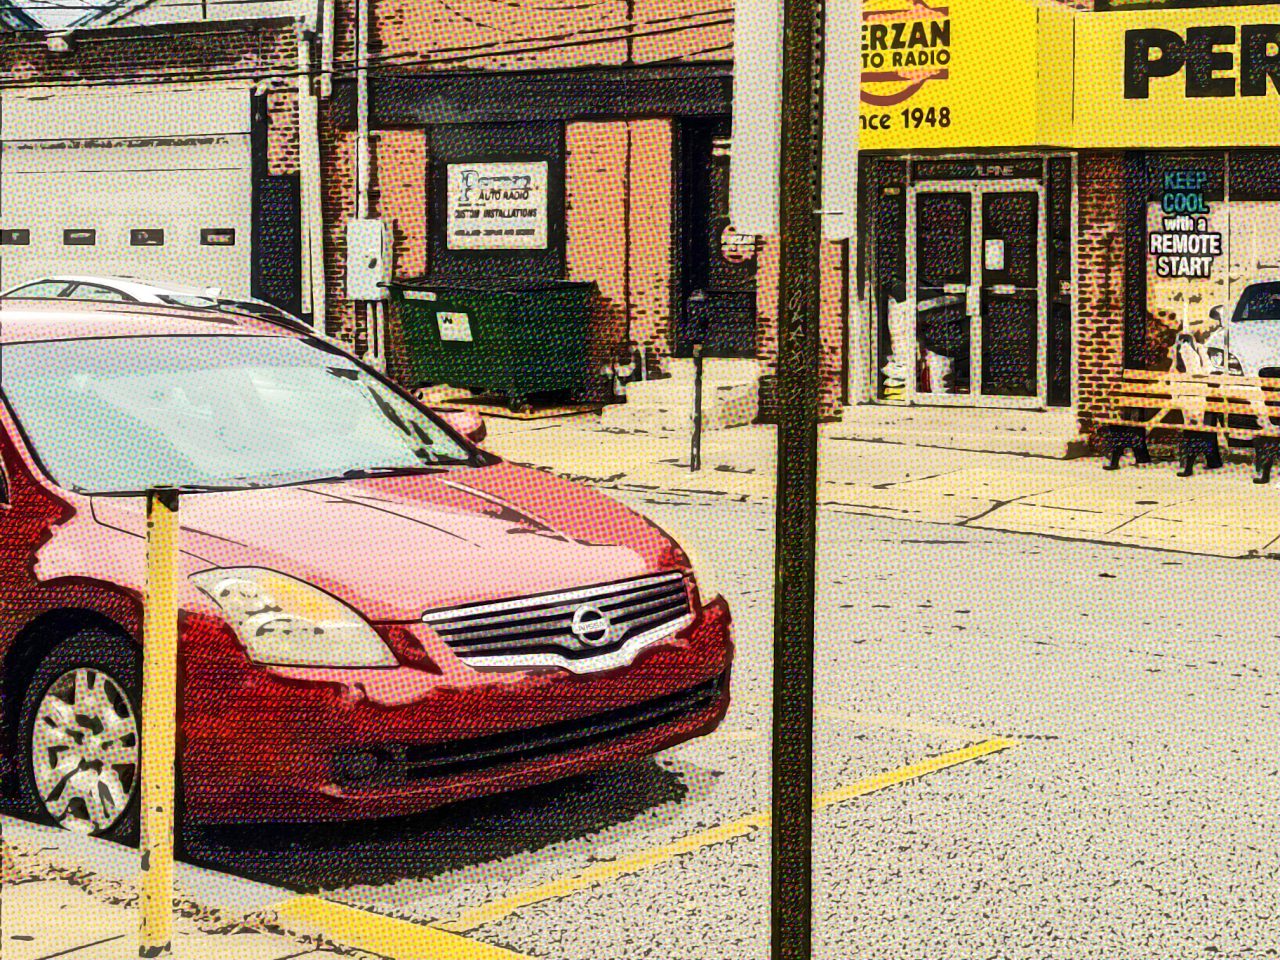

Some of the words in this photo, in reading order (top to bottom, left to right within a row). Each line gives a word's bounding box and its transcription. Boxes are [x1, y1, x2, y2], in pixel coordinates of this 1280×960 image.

[892, 49, 951, 67] RADIO
[901, 106, 951, 129] 1948
[1163, 170, 1207, 189] KEEP
[1163, 192, 1209, 213] COOL
[1164, 215, 1194, 231] with
[1197, 218, 1206, 231] a
[1150, 233, 1221, 254] REMOTE
[1158, 255, 1213, 277] START
